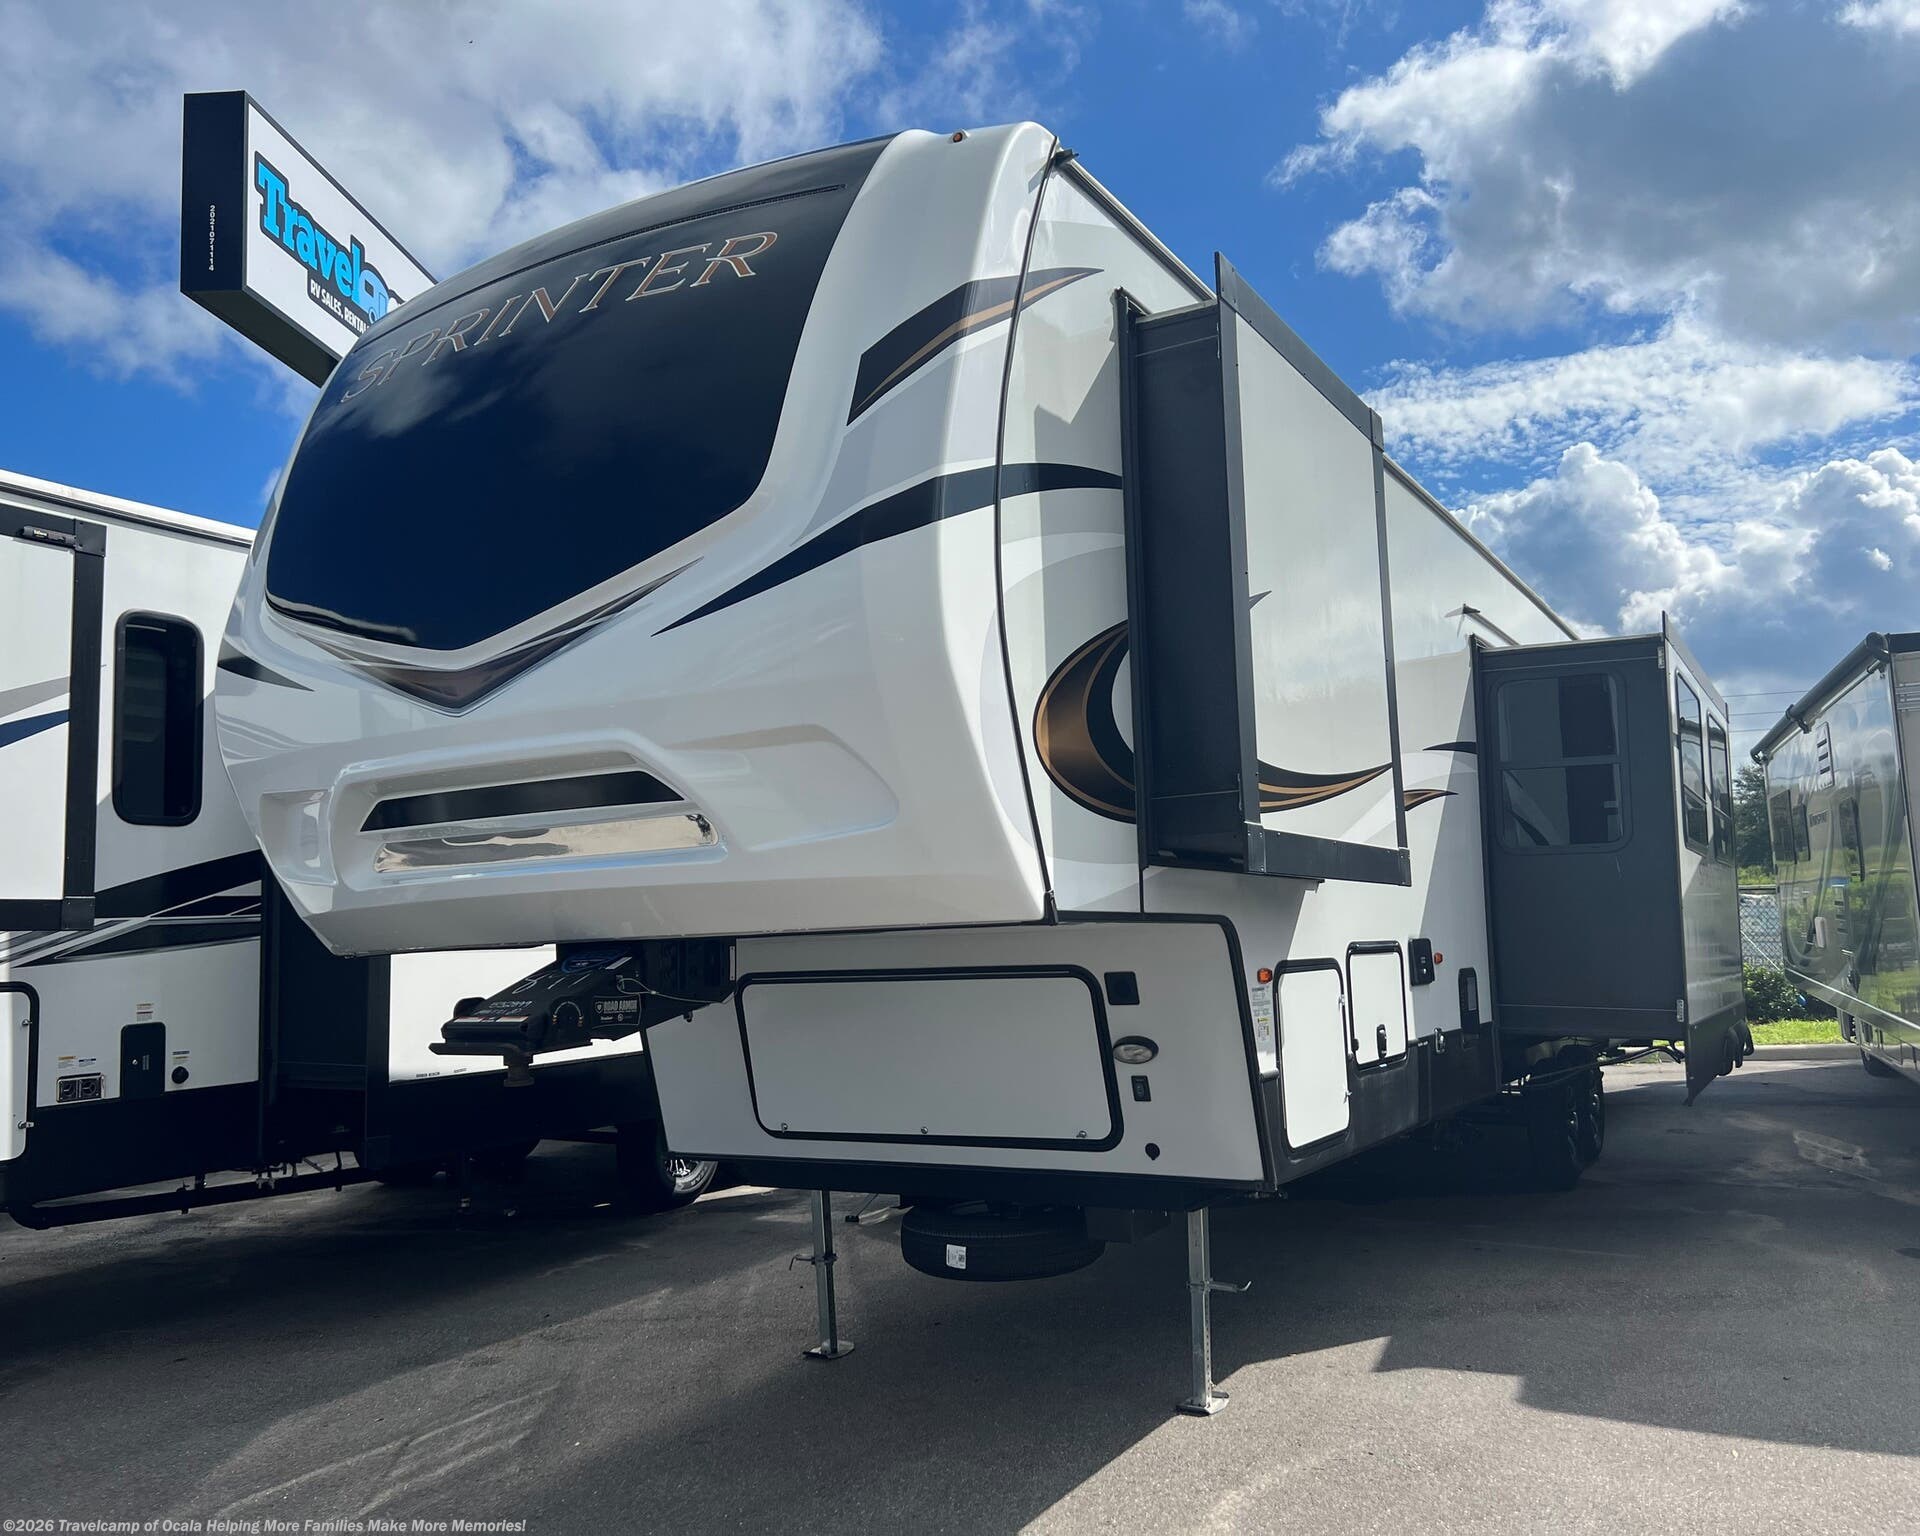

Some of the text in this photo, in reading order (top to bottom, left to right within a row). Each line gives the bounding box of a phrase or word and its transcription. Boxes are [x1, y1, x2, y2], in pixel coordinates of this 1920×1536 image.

[310, 279, 321, 299] RV
[344, 306, 370, 334] RENTAL
[340, 231, 778, 403] SPRINTER
